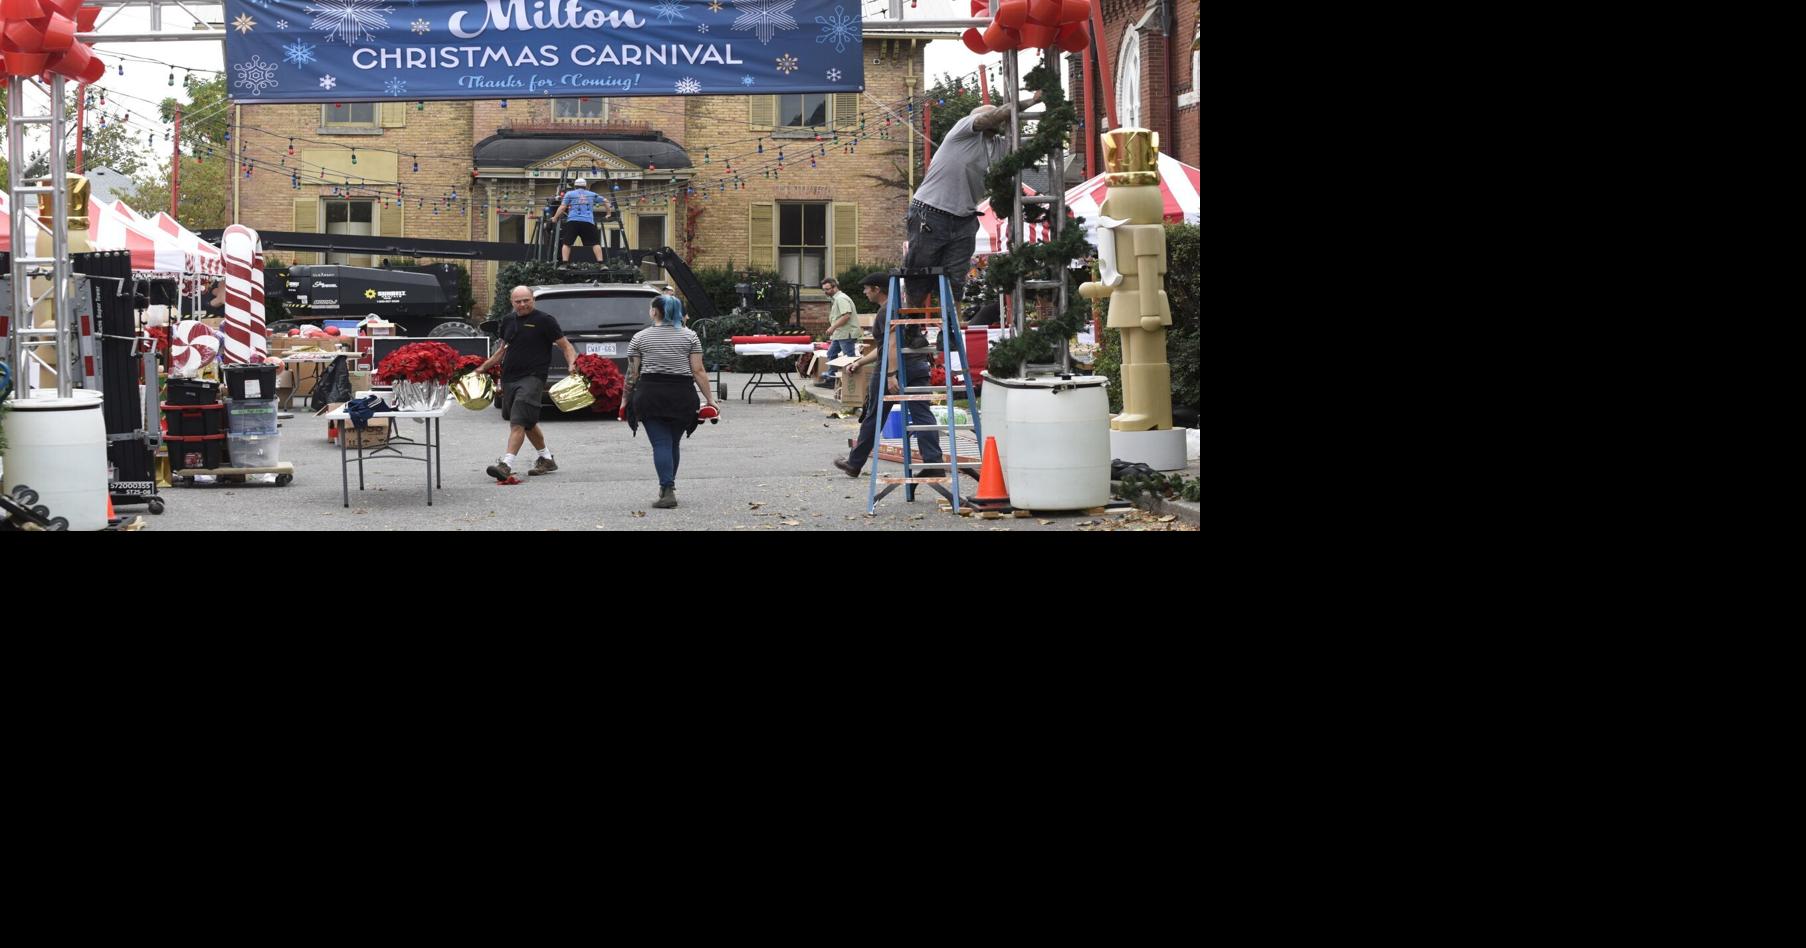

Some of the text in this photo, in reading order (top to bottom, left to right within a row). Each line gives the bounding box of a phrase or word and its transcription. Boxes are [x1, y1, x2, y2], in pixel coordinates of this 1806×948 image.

[448, 0, 645, 38] Milton
[352, 43, 743, 70] CHRISTMAS CARNIVAL
[458, 73, 641, 92] Thanks for Coming!
